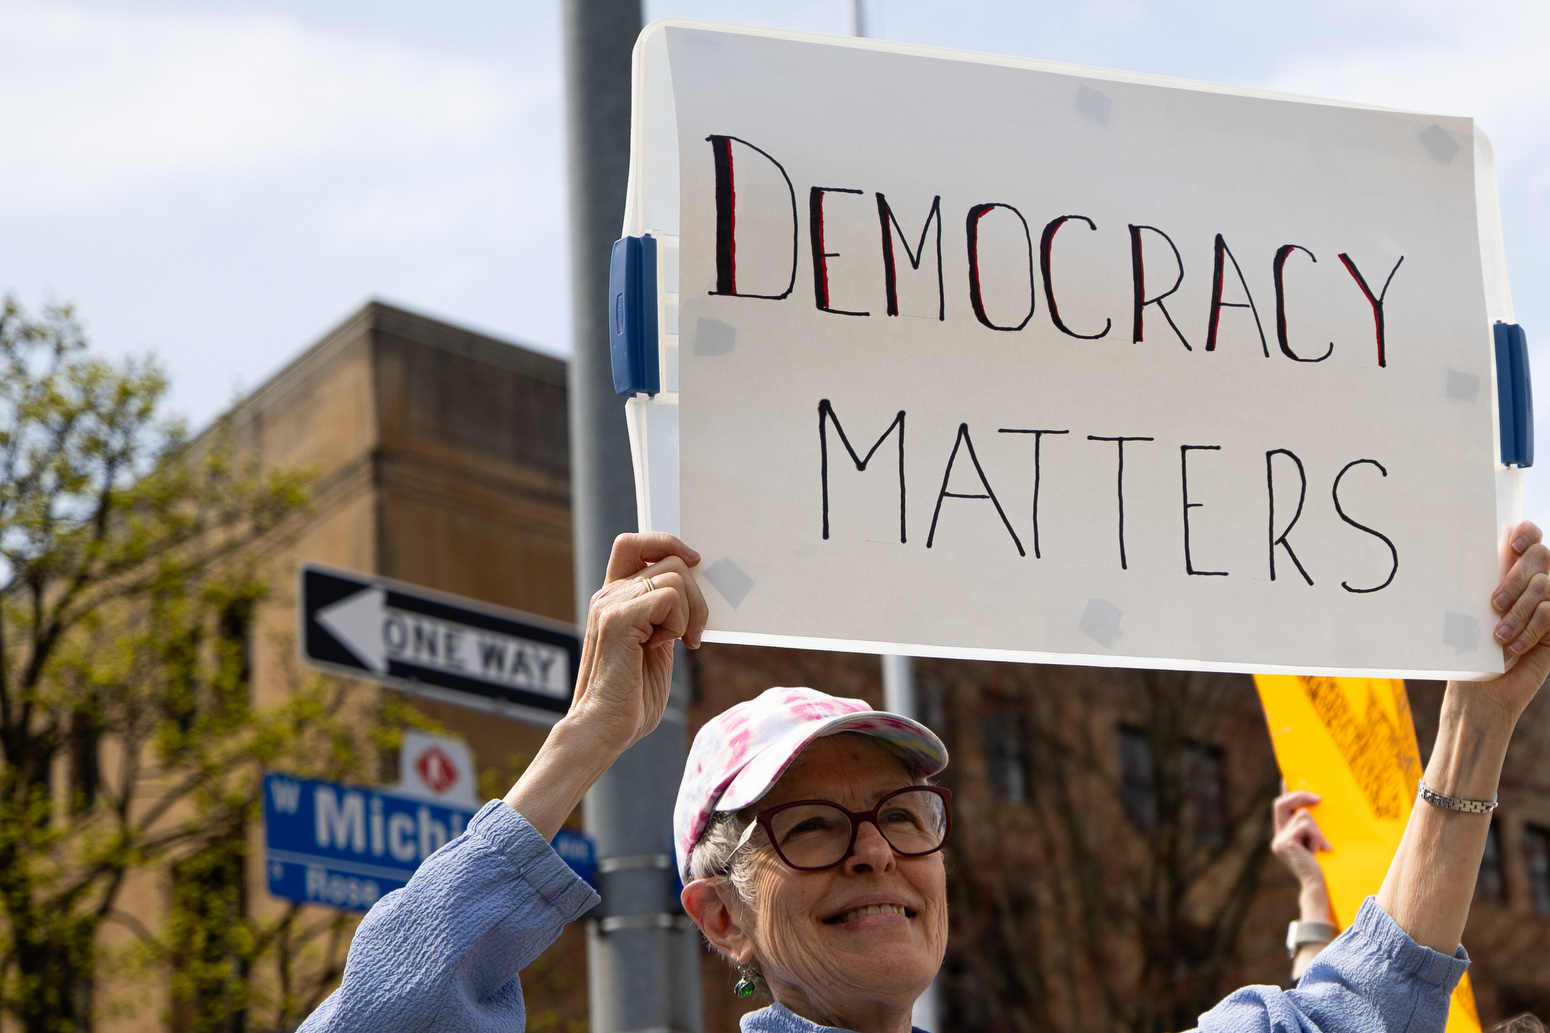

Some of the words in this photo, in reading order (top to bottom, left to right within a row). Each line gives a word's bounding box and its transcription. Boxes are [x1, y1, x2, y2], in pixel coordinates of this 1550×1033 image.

[705, 134, 1404, 368] DEMOCRACY
[817, 398, 1399, 593] MATTERS
[382, 614, 468, 668] ONE
[477, 638, 556, 685] WAY
[270, 780, 301, 814] W
